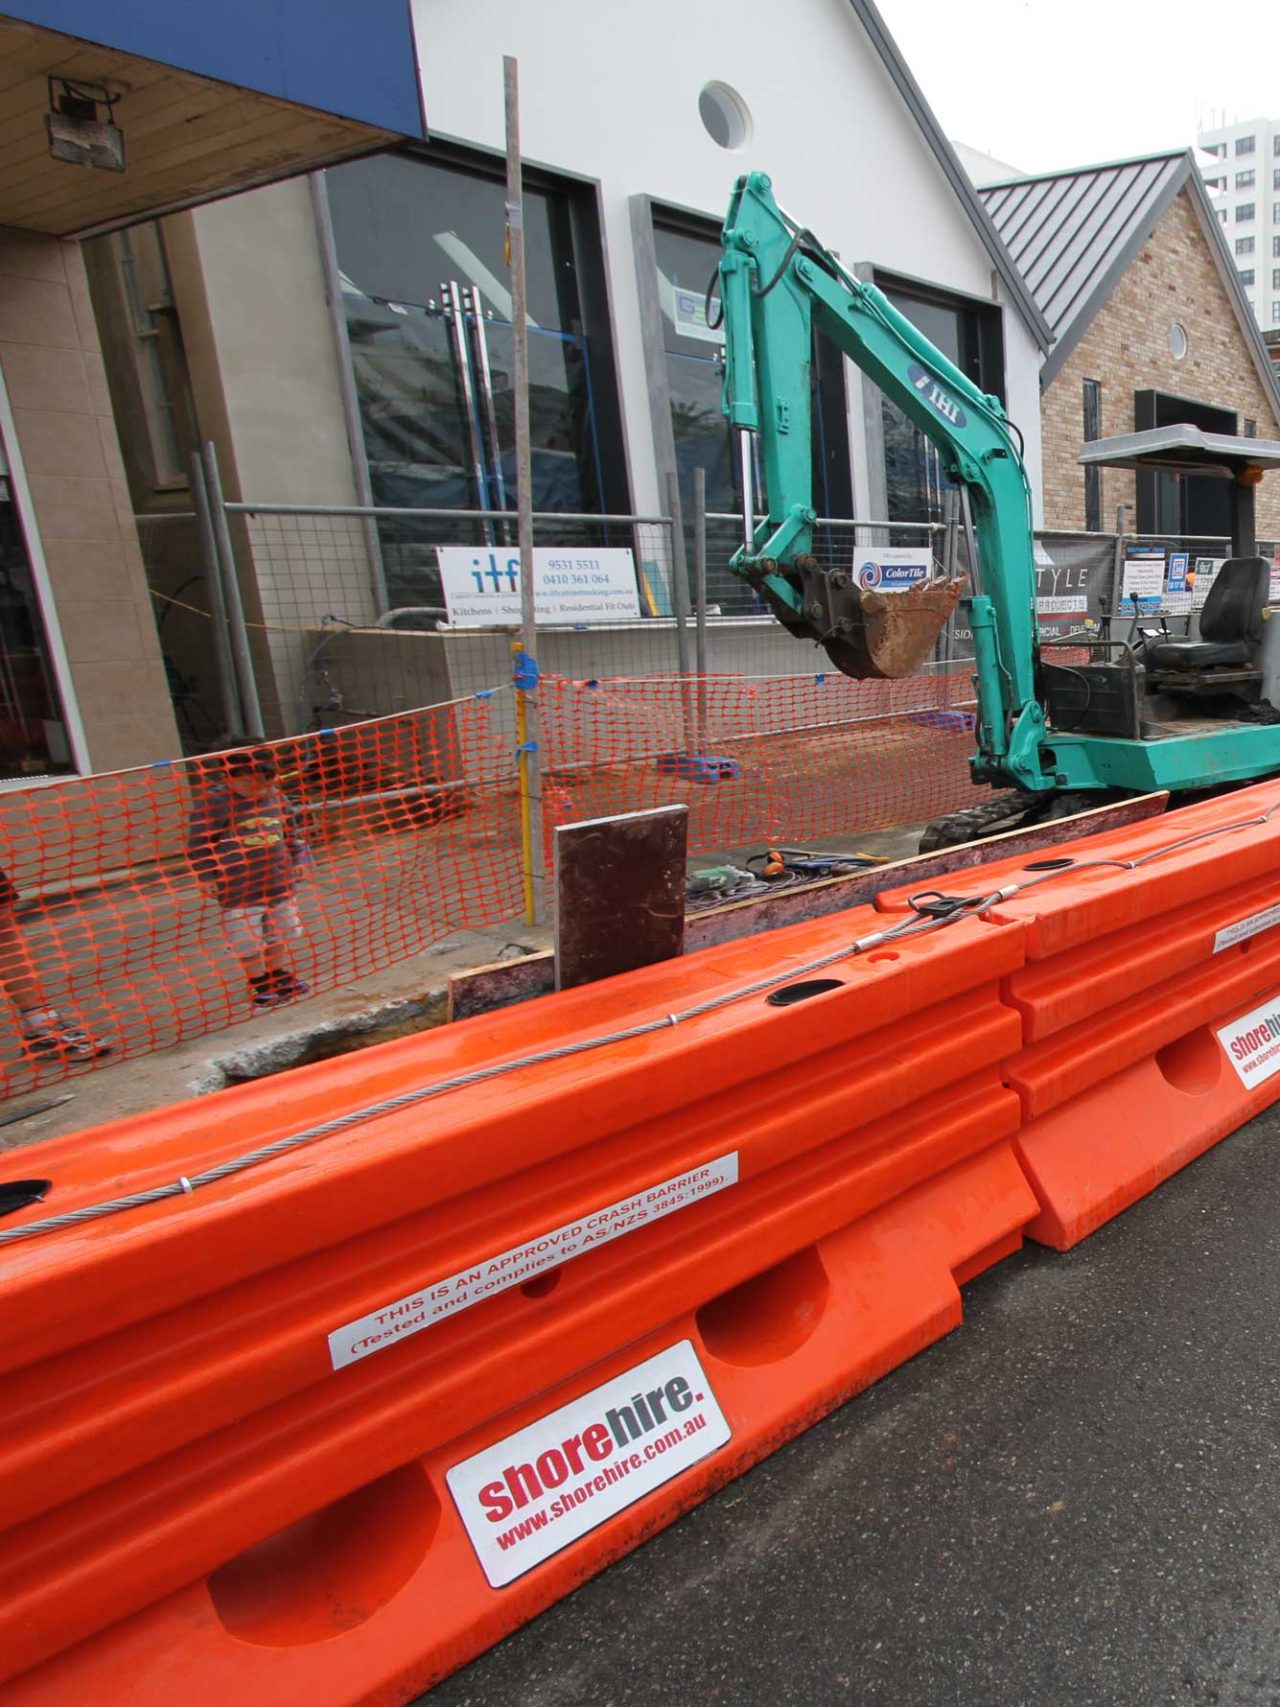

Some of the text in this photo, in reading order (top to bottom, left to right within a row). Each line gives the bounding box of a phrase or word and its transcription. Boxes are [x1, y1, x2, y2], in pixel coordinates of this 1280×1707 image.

[929, 384, 959, 424] IHI
[472, 554, 520, 593] itf
[543, 574, 568, 585] 0410
[570, 574, 589, 584] 361
[548, 560, 600, 570] 9531 5511
[885, 567, 924, 579] ColorTile
[1035, 568, 1088, 598] TYLE
[452, 606, 493, 617] Kitchens
[559, 602, 604, 613] Residential
[616, 601, 635, 611] Outs
[1038, 600, 1087, 614] PROJECTS
[375, 1168, 710, 1325] THIS IS AN APPROVED CRASH BARRIER
[351, 1311, 426, 1355] (Tested
[432, 1292, 468, 1316] and
[474, 1253, 556, 1296] complies
[561, 1244, 577, 1256] to
[582, 1210, 649, 1246] AS/NZS
[478, 1376, 705, 1524] shorehire.
[495, 1413, 708, 1552] www.shorehire.com.au
